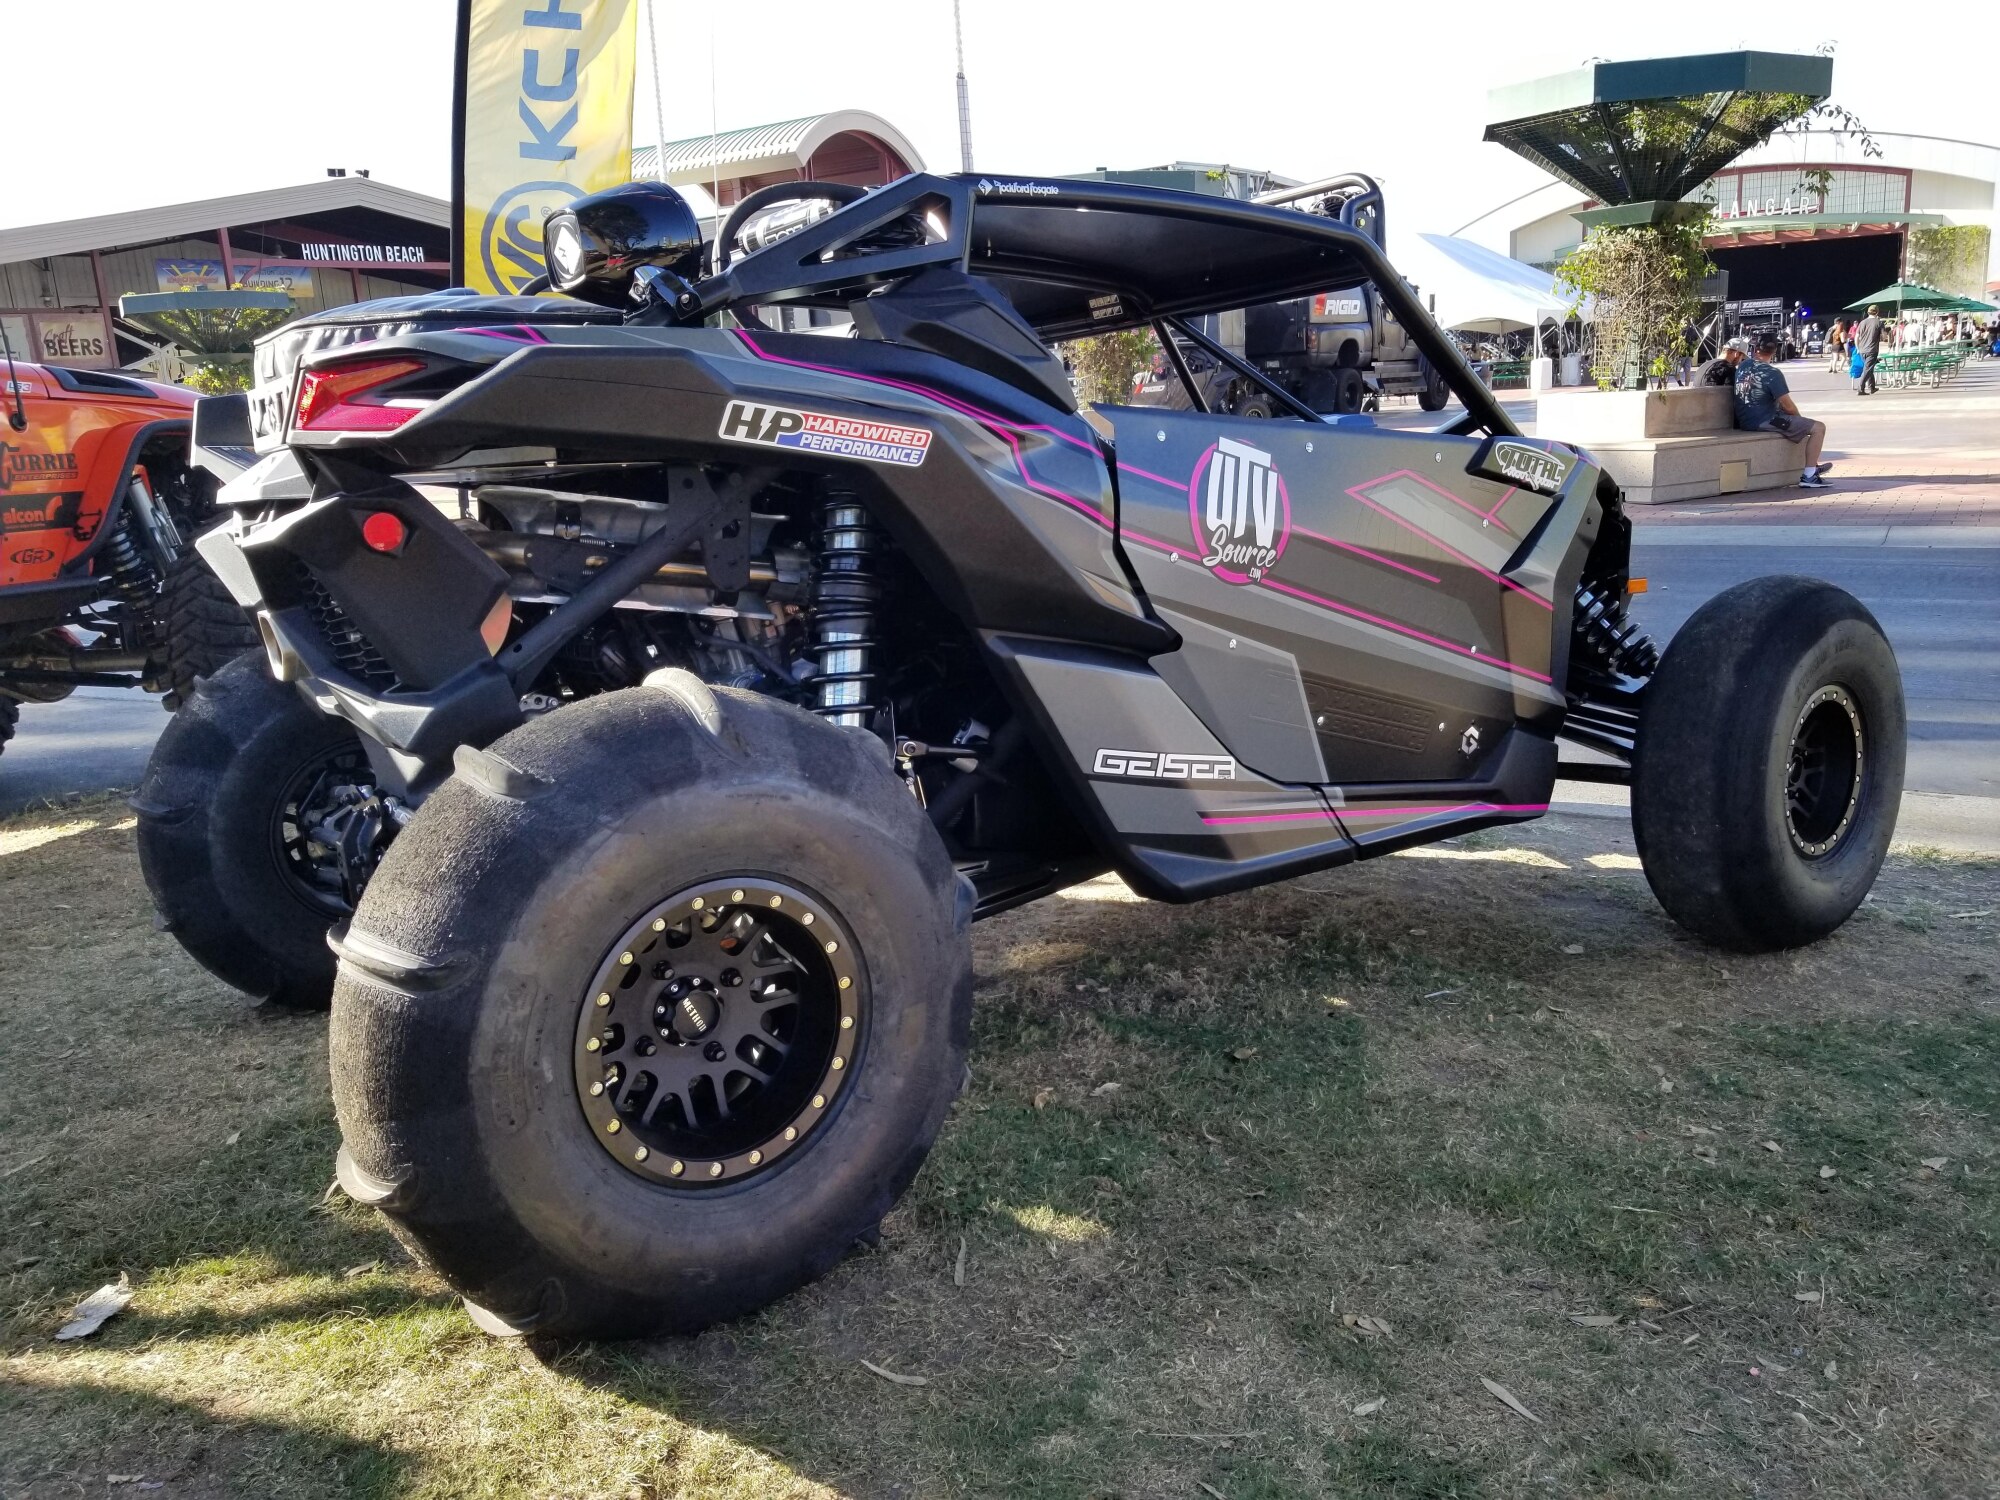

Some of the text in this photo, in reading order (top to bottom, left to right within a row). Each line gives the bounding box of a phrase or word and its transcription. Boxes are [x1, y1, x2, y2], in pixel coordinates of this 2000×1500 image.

[1712, 196, 1810, 220] HANGAR
[301, 243, 424, 263] HUNTINGTON BEACH
[1324, 299, 1361, 316] RIGID
[45, 338, 104, 357] BEERS
[723, 404, 803, 443] HP
[806, 416, 928, 447] HARDWIRED
[799, 433, 922, 464] PERFORMANCE
[14, 472, 77, 481] ENTERPRISES
[1206, 436, 1279, 549] UTV
[3, 507, 45, 523] alcon
[1202, 526, 1277, 567] Source
[1093, 748, 1236, 780] GEISER
[682, 997, 707, 1032] METHOD
